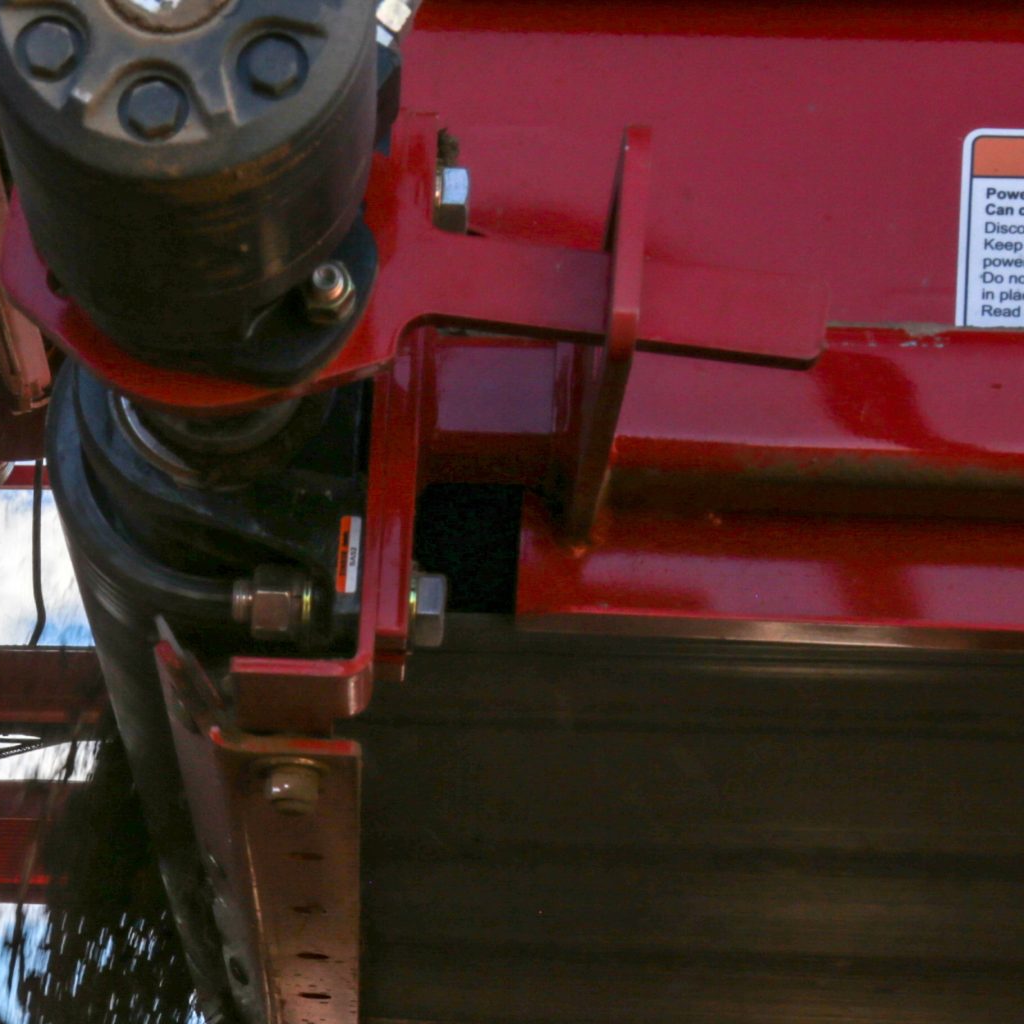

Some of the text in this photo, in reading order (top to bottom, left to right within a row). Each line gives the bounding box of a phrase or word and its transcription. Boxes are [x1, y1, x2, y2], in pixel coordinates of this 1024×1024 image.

[985, 203, 1014, 216] Can
[984, 221, 1024, 234] Disco
[984, 238, 1023, 253] Keep
[982, 271, 1004, 284] Do
[981, 287, 994, 300] in
[981, 304, 1021, 318] Read
